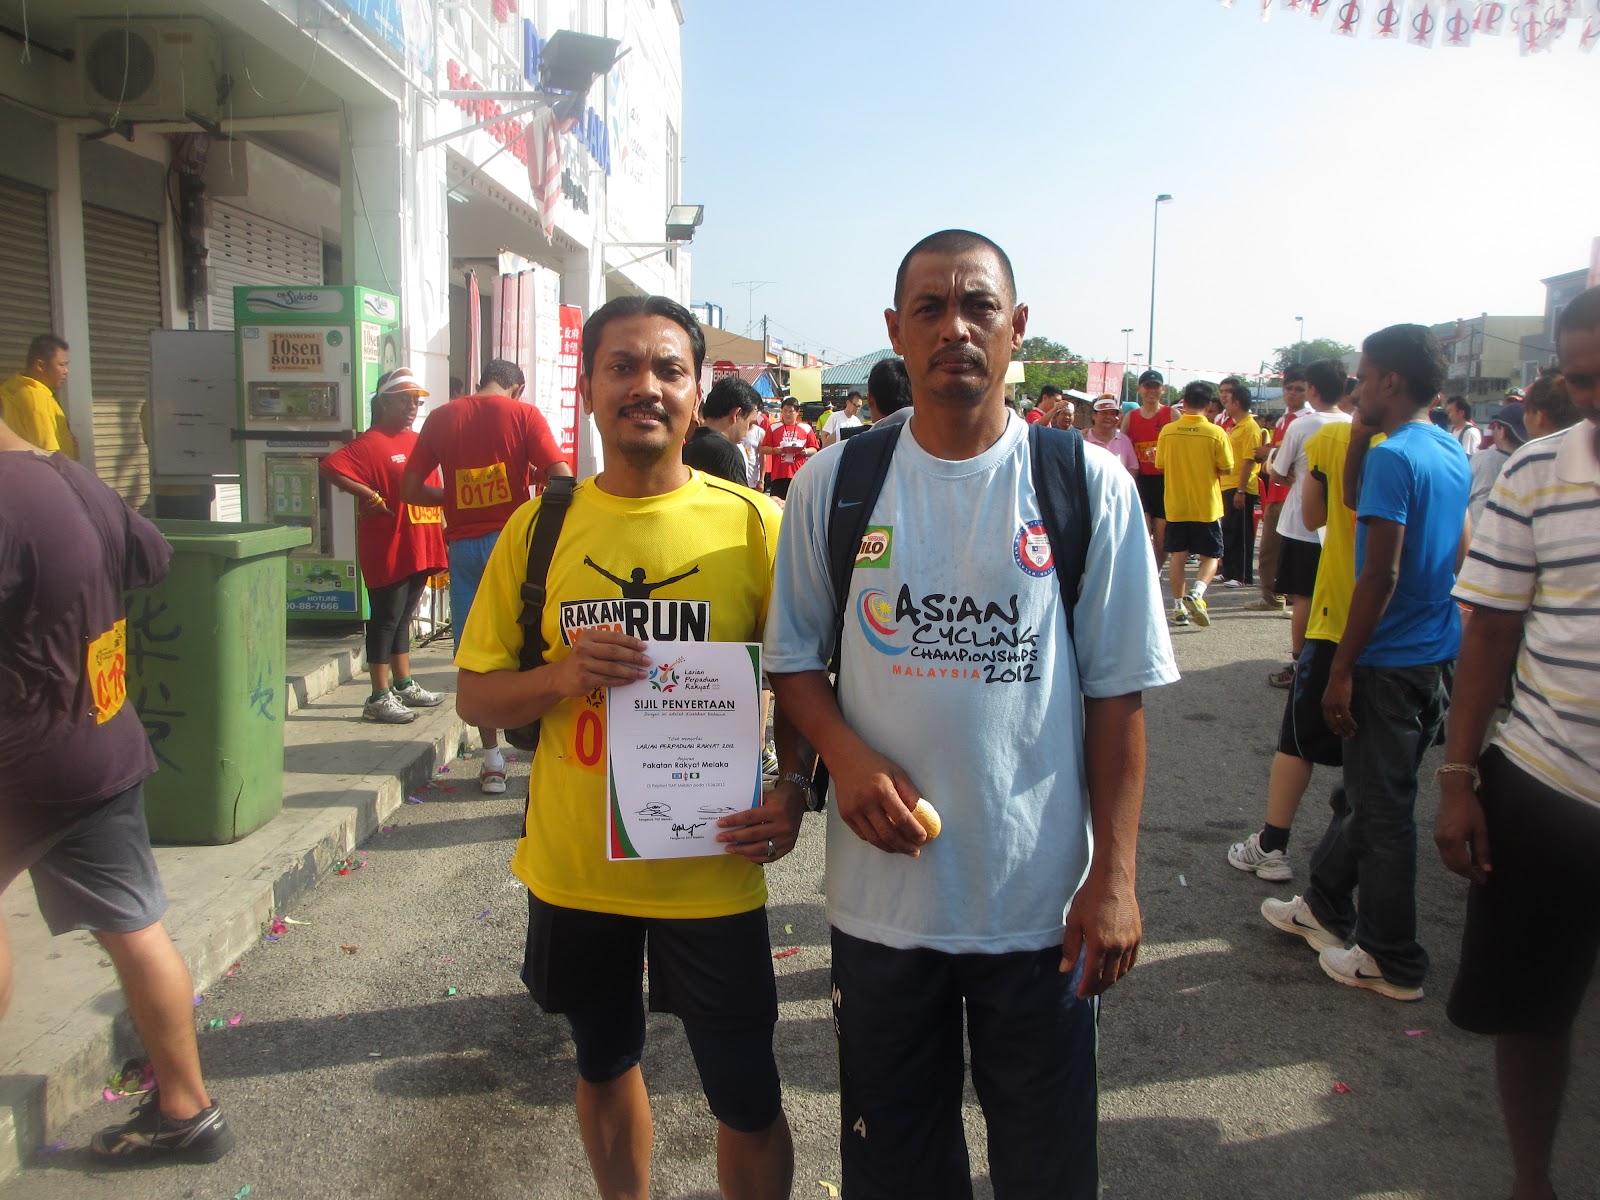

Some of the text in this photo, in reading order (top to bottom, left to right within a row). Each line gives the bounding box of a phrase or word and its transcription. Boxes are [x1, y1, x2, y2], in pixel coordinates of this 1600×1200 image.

[271, 339, 320, 356] 10sen
[271, 356, 321, 365] 800ml
[461, 478, 509, 506] 0175
[858, 541, 884, 555] ILO
[564, 601, 625, 628] RAKAN
[625, 601, 707, 642] RUN
[684, 676, 719, 685] Perpaduan
[892, 664, 1041, 685] MALAYSIA 2012
[634, 699, 735, 710] SIJIL PENYERTAAN
[674, 761, 700, 770] Rakyat
